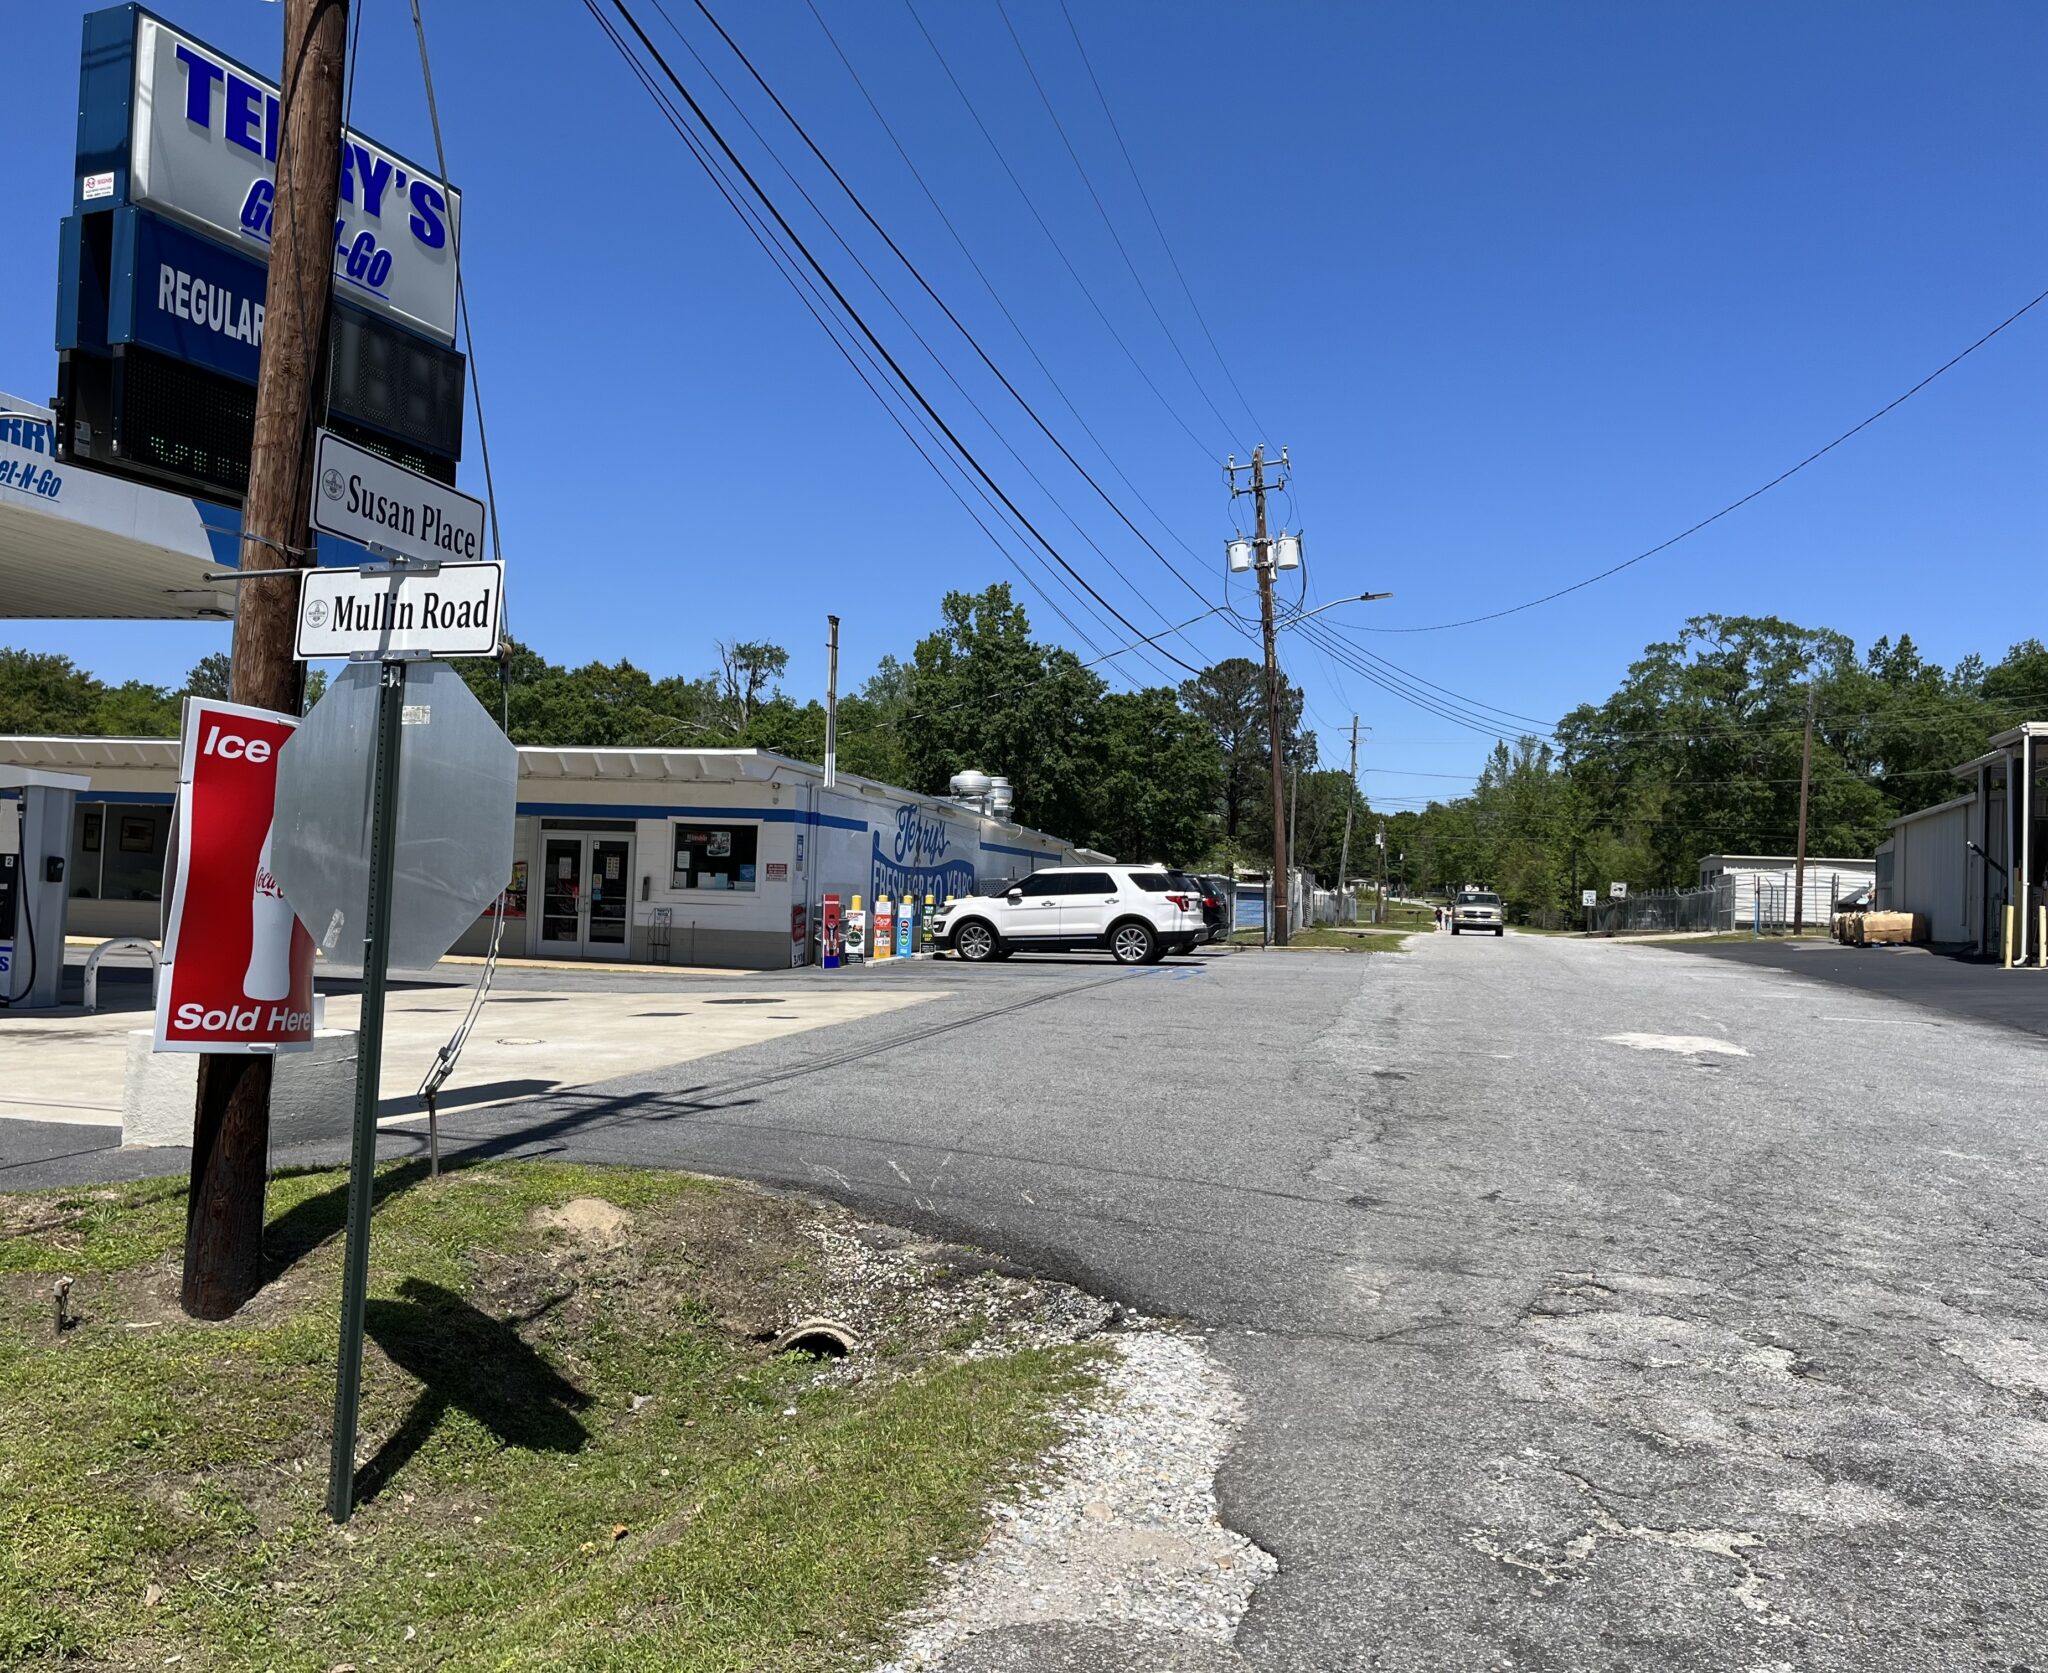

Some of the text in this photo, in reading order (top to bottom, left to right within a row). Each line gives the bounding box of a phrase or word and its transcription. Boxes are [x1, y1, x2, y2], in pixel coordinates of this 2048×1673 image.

[158, 263, 266, 347] REGULAR
[347, 474, 415, 537] Susan
[420, 503, 476, 559] Place
[331, 591, 414, 632] Mullin
[420, 588, 490, 630] Road
[203, 725, 271, 763] Ice
[894, 803, 951, 866] Terry's
[7, 856, 13, 867] 2
[173, 1002, 312, 1032] Sold Here
